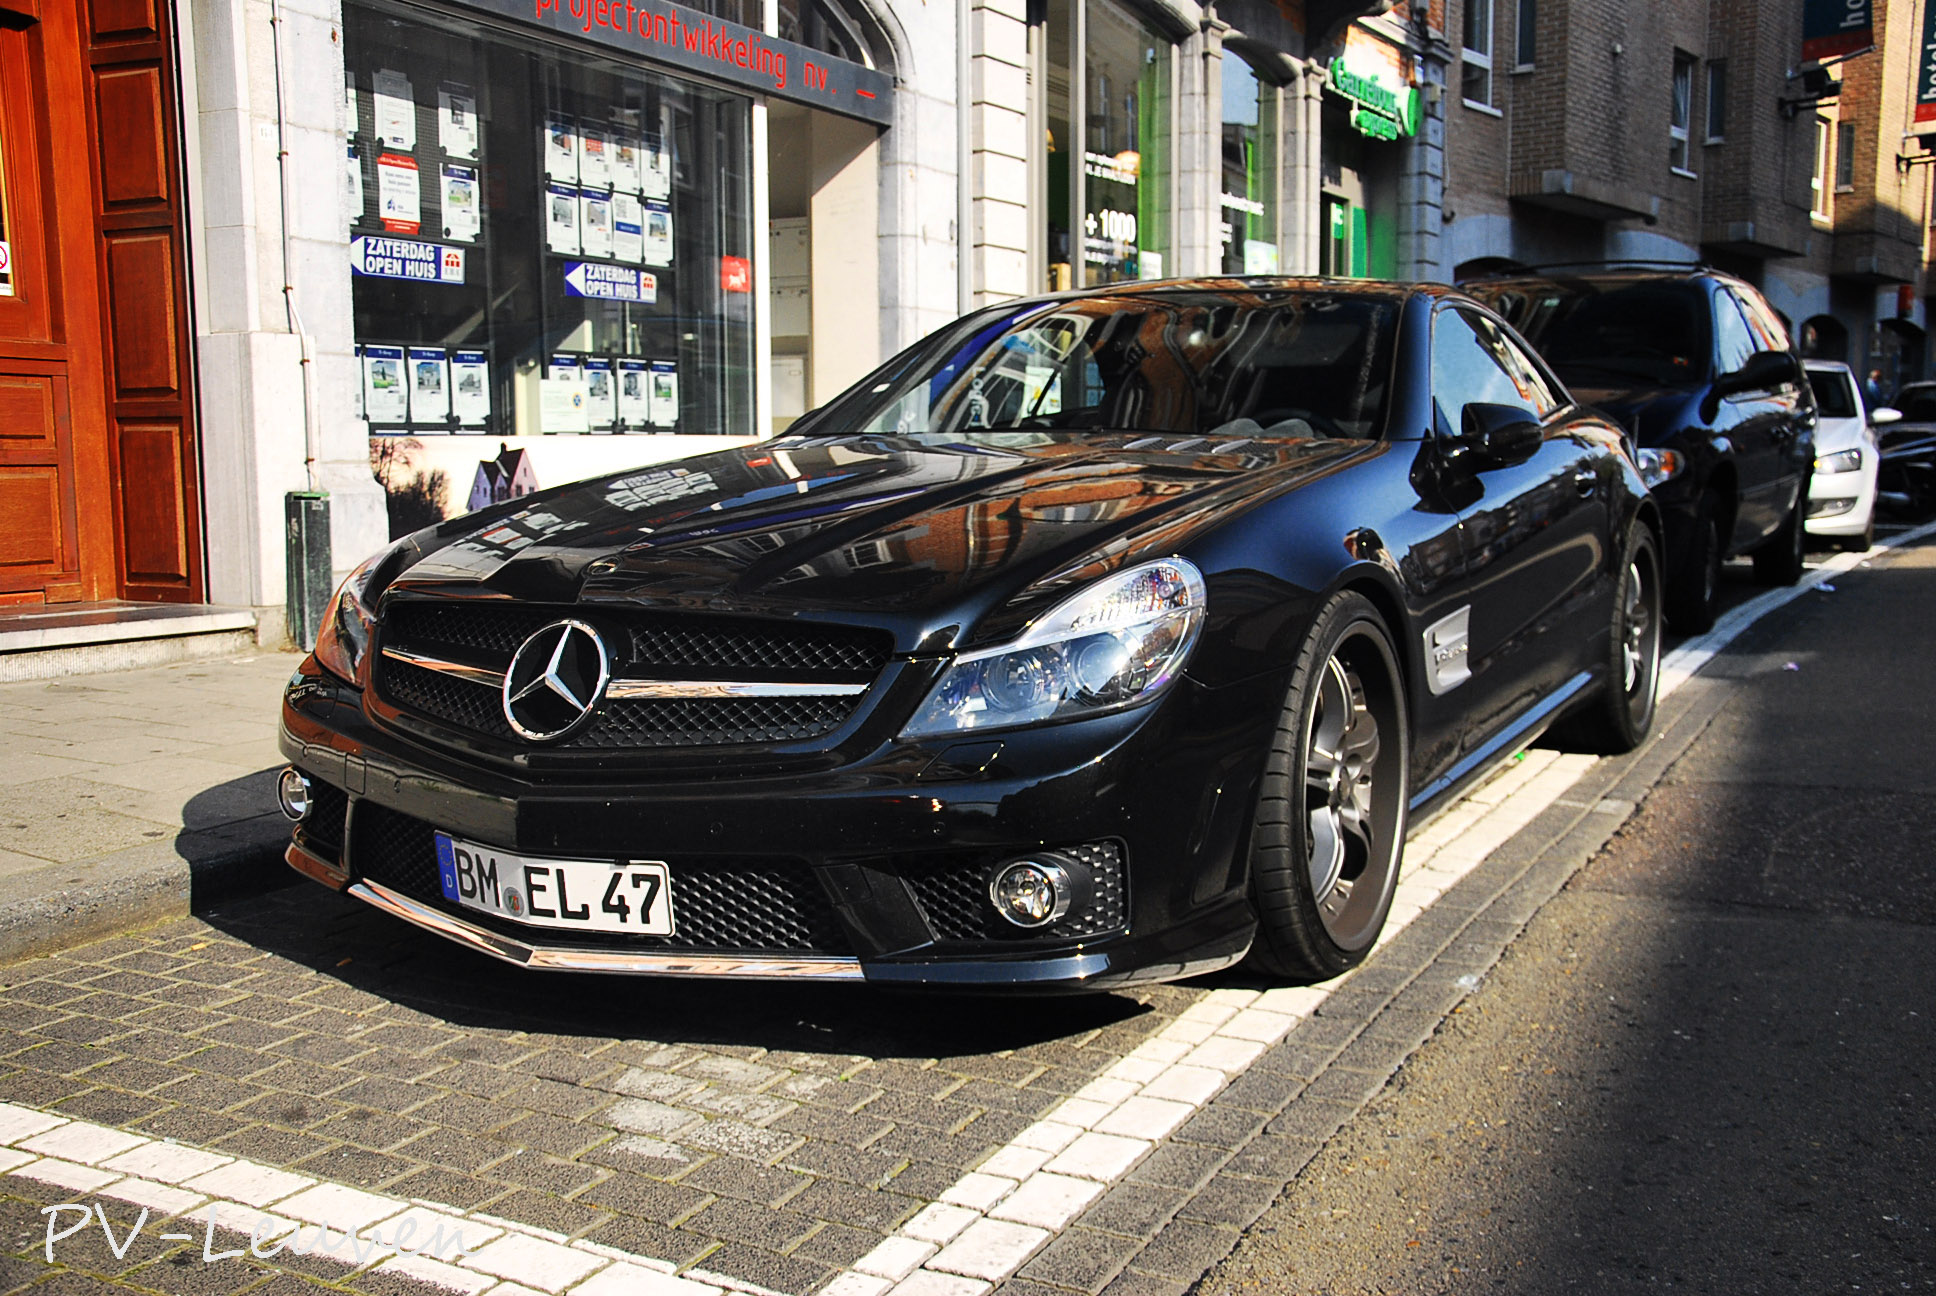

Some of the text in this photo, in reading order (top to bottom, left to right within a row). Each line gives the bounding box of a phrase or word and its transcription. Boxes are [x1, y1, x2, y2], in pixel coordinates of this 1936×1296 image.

[803, 61, 837, 94] nv.
[1100, 208, 1137, 243] 1000
[366, 238, 435, 262] ZATERDAG
[365, 255, 403, 275] OPEN
[405, 260, 437, 280] HUIS
[586, 264, 637, 285] ZATERDAG
[586, 280, 614, 297] OPEN
[614, 283, 638, 299] HUIS
[454, 847, 661, 925] BM EL 47
